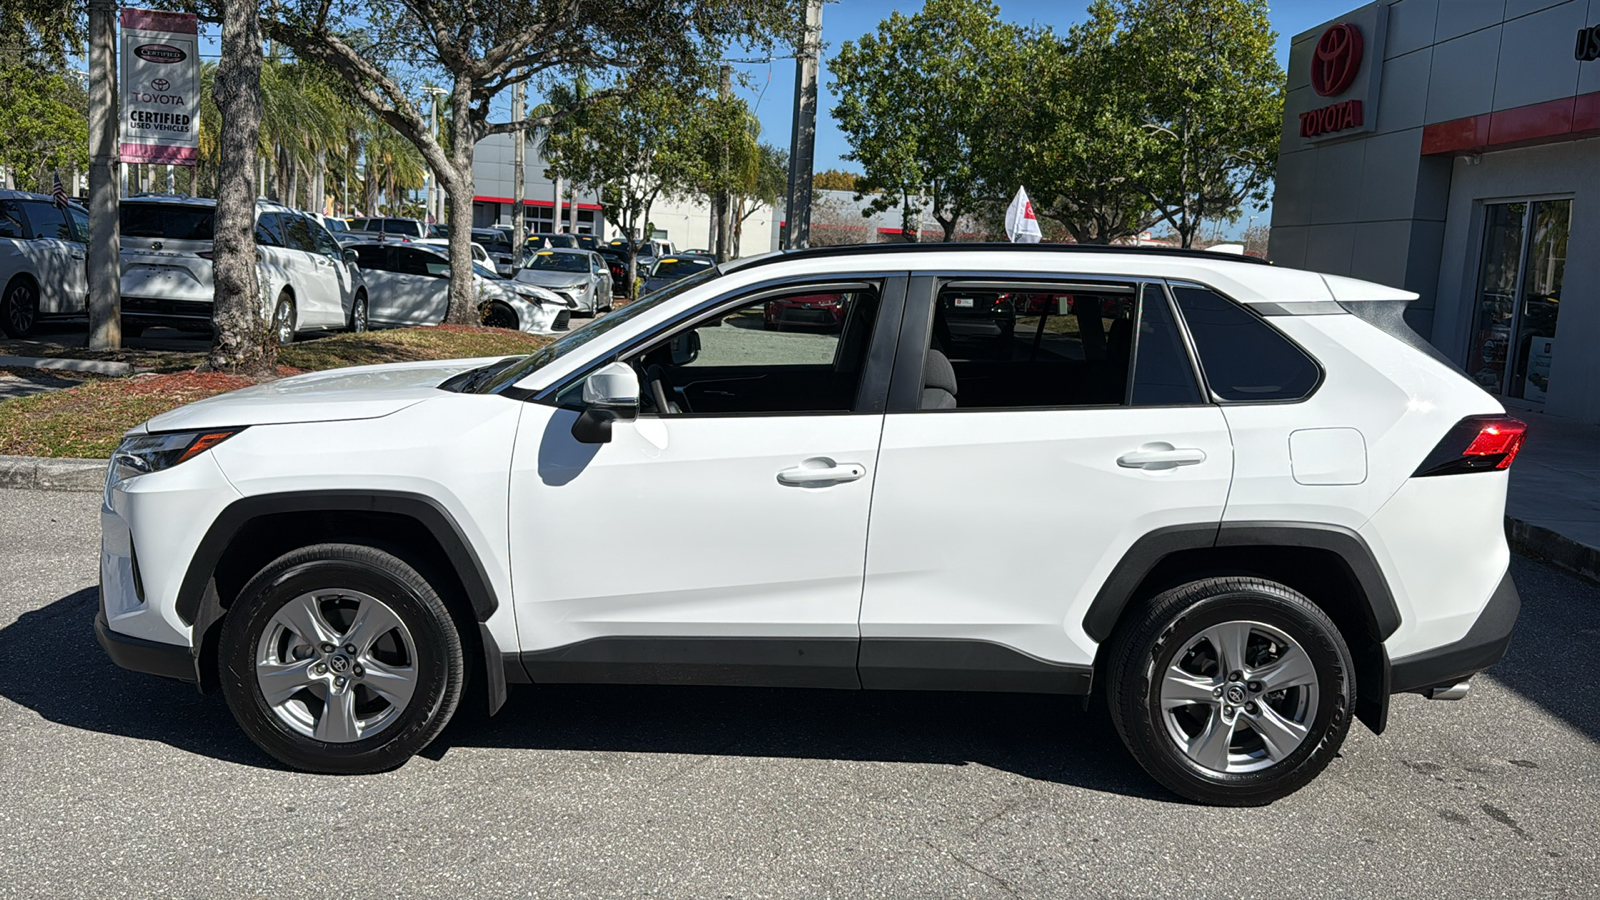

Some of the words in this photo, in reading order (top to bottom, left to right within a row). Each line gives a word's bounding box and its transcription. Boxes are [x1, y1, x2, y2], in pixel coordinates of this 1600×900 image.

[140, 49, 181, 58] CERTIFIED
[132, 92, 185, 106] TOYOTA
[130, 110, 190, 126] CERTIFIED
[1299, 100, 1362, 137] TOYOTA
[130, 121, 151, 130] USED
[153, 123, 190, 133] VEHICLES
